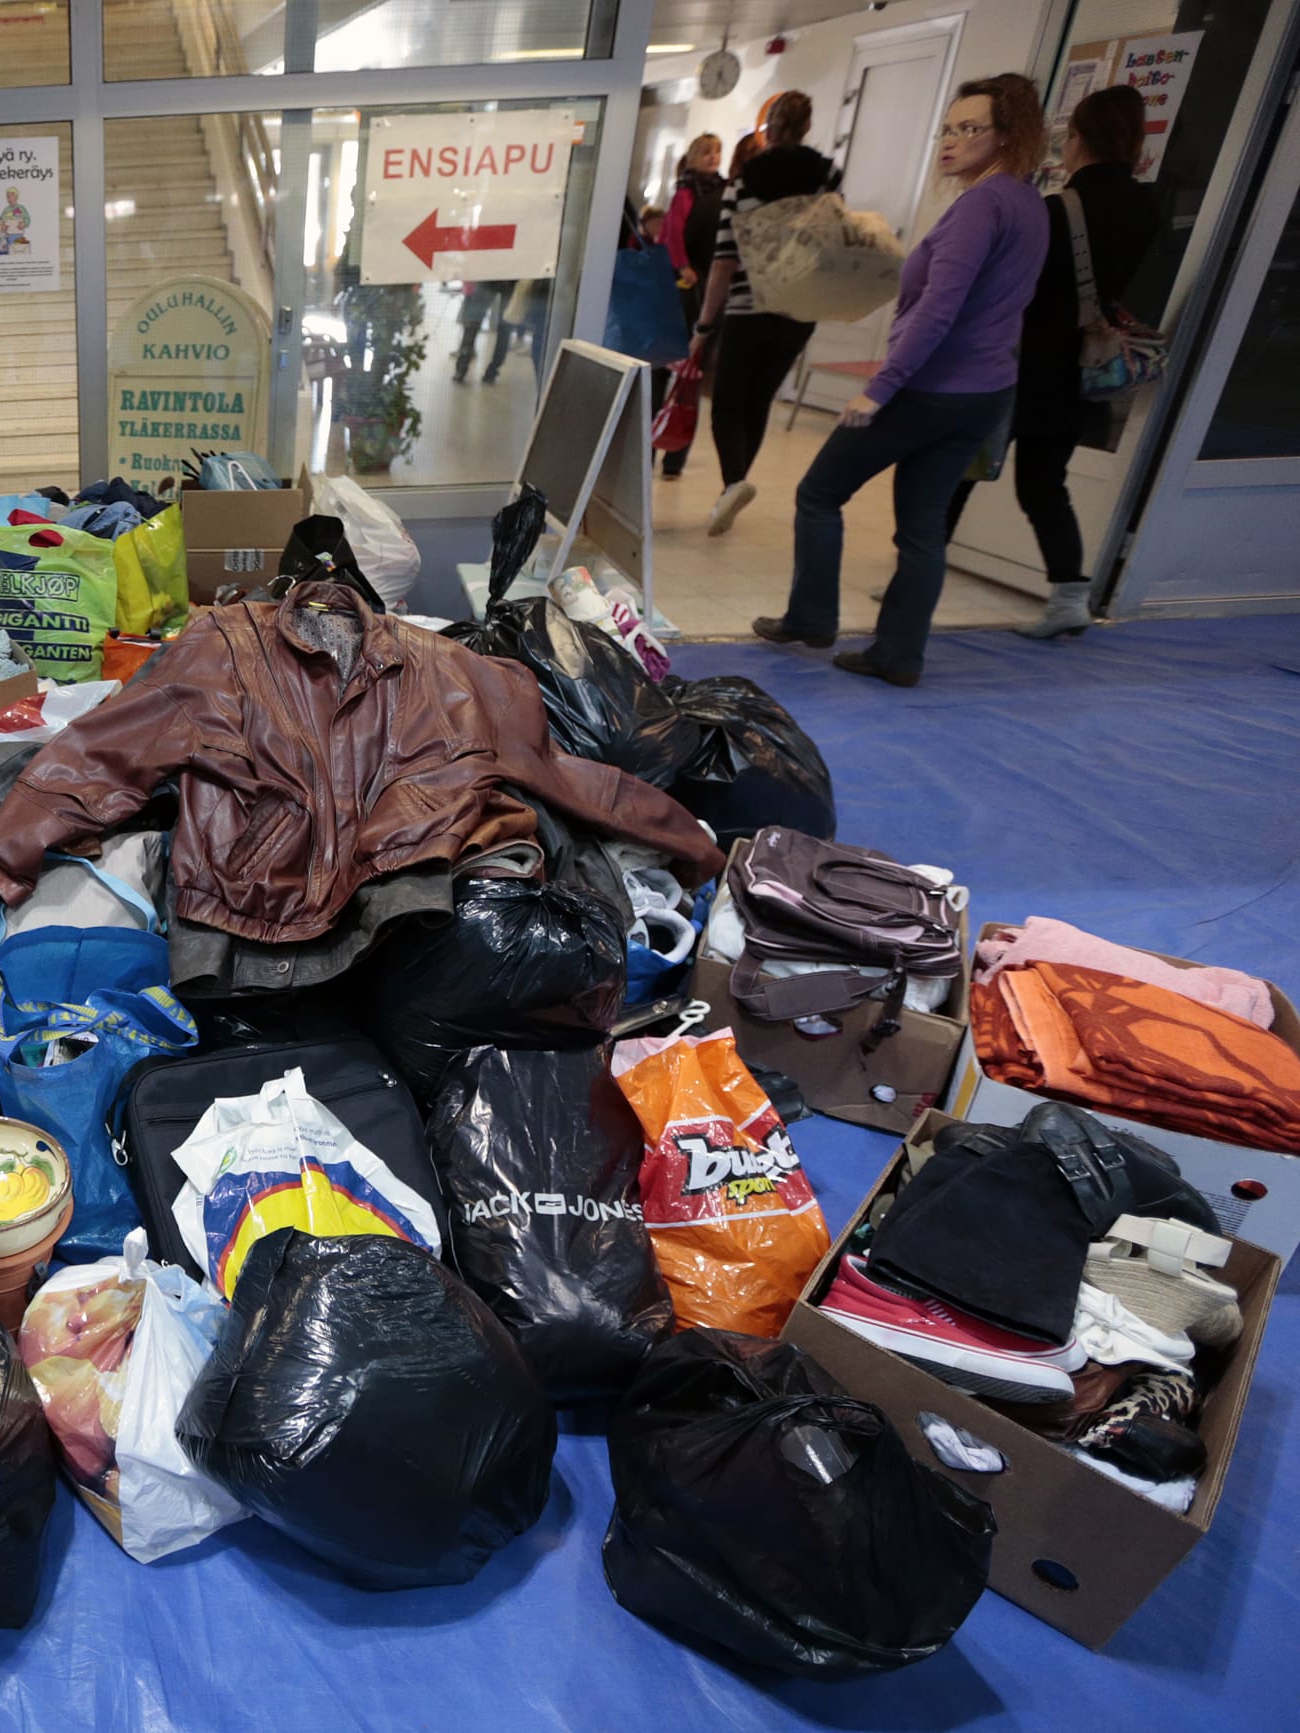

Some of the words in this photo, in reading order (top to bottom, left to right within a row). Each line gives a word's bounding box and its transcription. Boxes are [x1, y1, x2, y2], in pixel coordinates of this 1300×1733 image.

[382, 143, 555, 180] ENSIAPU
[137, 292, 237, 336] OULUHALLIN
[143, 344, 230, 360] KAHVIO
[120, 390, 245, 413] RAVINTOLA
[119, 417, 242, 441] YLÄKERRASSA
[22, 645, 91, 659] GANTEN
[462, 1191, 533, 1227] JACK
